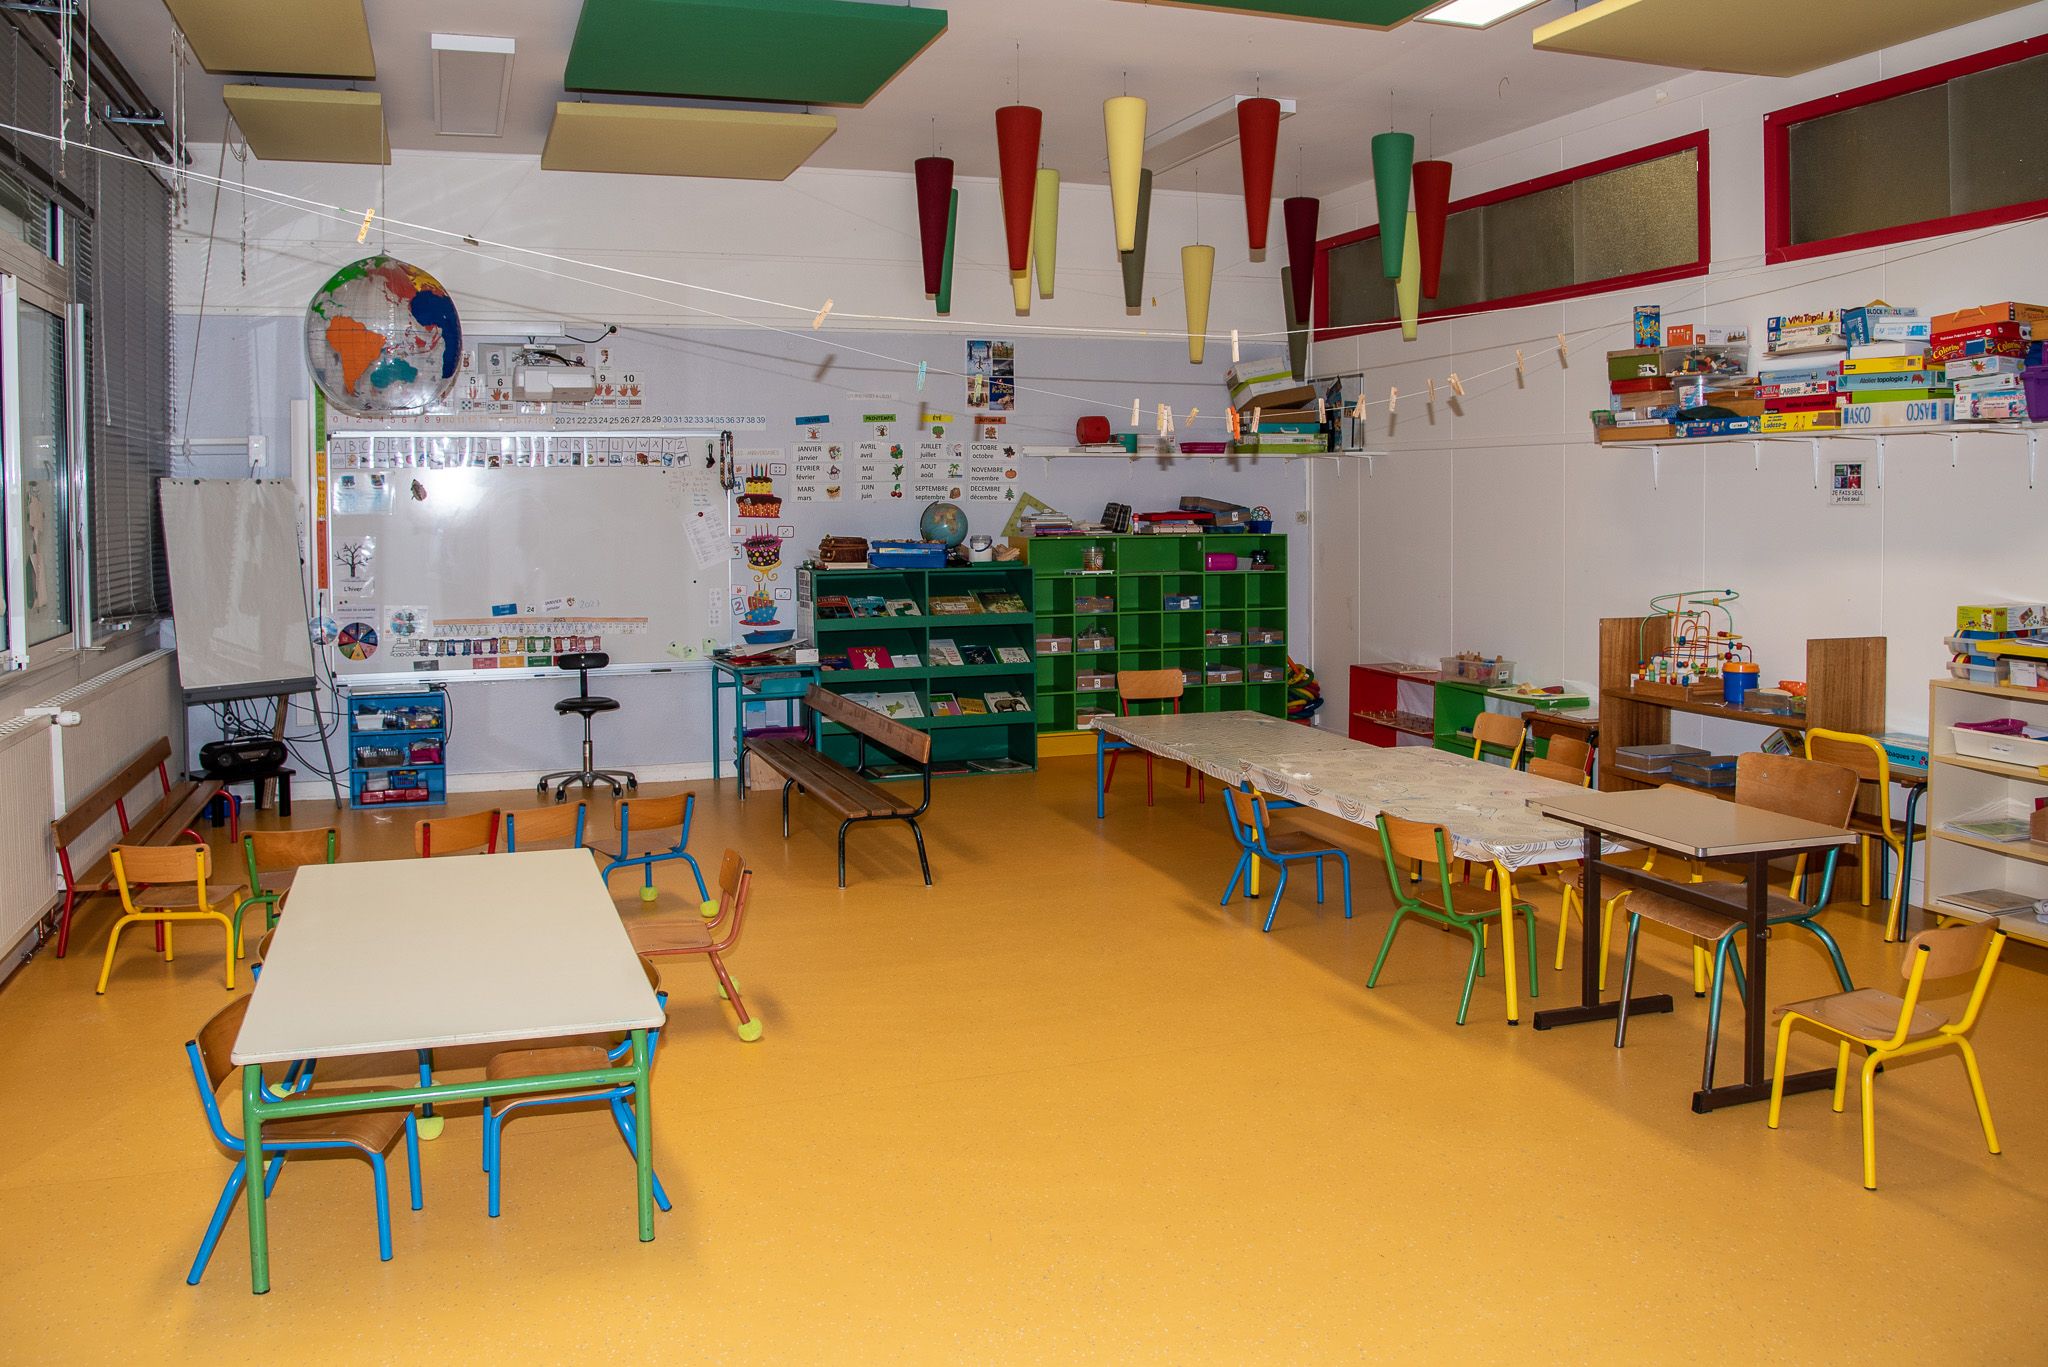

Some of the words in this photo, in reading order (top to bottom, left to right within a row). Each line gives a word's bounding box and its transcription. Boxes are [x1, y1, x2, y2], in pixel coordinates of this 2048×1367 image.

[1997, 342, 2022, 353] Colorino
[1932, 345, 1960, 360] Colorino
[470, 376, 477, 385] 5
[497, 378, 504, 387] 6
[600, 374, 607, 382] 9
[623, 374, 635, 383] 10
[1876, 375, 1903, 384] topologie
[1849, 406, 1871, 424] ASCO
[1906, 402, 1931, 421] ASCO
[401, 416, 407, 424] 6
[424, 416, 430, 424] 8
[435, 416, 441, 424] 9
[555, 416, 565, 425] 20
[567, 416, 575, 425] 21
[577, 416, 587, 425] 22
[588, 416, 598, 425] 23
[598, 416, 608, 425] 24
[609, 416, 619, 425] 25
[619, 416, 630, 425] 26
[630, 416, 640, 425] 27
[641, 416, 651, 425] 28
[651, 416, 662, 424] 29
[662, 416, 673, 424] 30
[673, 416, 683, 424] 31
[683, 416, 694, 424] 32
[694, 416, 704, 424] 33
[704, 416, 715, 424] 34
[715, 416, 725, 424] 35
[725, 416, 735, 424] 36
[736, 416, 746, 424] 37
[746, 416, 756, 424] 38
[756, 416, 766, 424] 39
[333, 440, 342, 450] A
[349, 440, 356, 450] B
[361, 440, 368, 450] C
[377, 440, 385, 450] D
[491, 442, 498, 451] L
[559, 440, 568, 449] Q
[574, 440, 581, 449] R
[587, 440, 594, 450] S
[598, 440, 607, 450] T
[612, 440, 619, 450] U
[627, 440, 634, 449] V
[639, 440, 648, 449] W
[652, 440, 660, 449] X
[665, 440, 673, 450] Y
[677, 440, 684, 450] Z
[798, 454, 819, 462] janvier
[919, 451, 937, 459] juillet
[796, 464, 821, 472] FEVRIER
[734, 479, 742, 491] 4
[797, 485, 816, 493] MARS
[861, 493, 873, 501] juin
[914, 493, 946, 501] septembre
[343, 585, 363, 593] L'hiver
[526, 605, 535, 613] 24
[734, 600, 742, 612] 2
